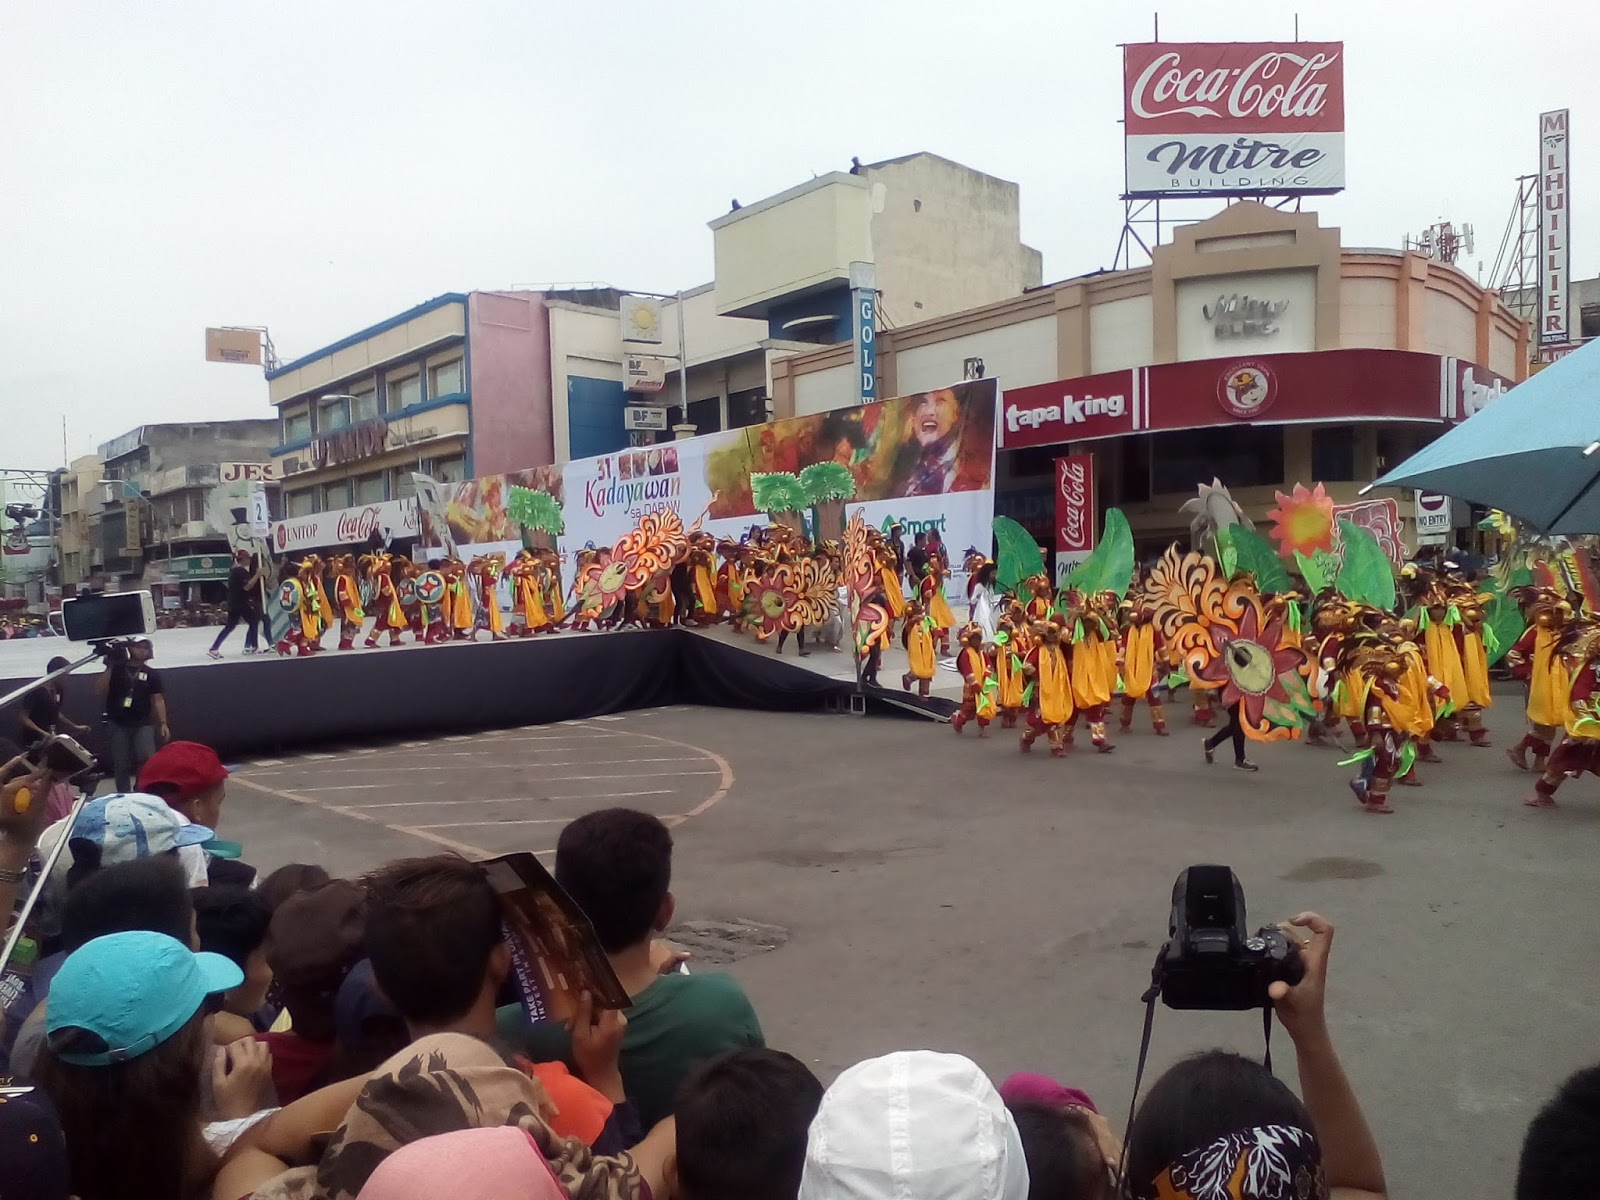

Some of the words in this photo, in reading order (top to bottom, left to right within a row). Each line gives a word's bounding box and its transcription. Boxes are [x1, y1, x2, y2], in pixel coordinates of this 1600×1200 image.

[1131, 52, 1340, 119] Coca-Cola
[1147, 137, 1326, 175] Mitre
[1171, 176, 1309, 187] BUILDING
[1006, 404, 1061, 432] tapa
[585, 476, 680, 517] Kadayawan
[1061, 460, 1084, 547] Coca-Cola
[631, 507, 640, 519] sa
[899, 513, 946, 535] Smart
[1419, 516, 1426, 526] NO
[1429, 514, 1448, 525] ENTRY
[287, 523, 318, 542] UNITOP
[512, 953, 520, 966] IN
[517, 967, 531, 994] PART
[526, 994, 540, 1023] TAKE
[529, 979, 546, 1020] INVEST
